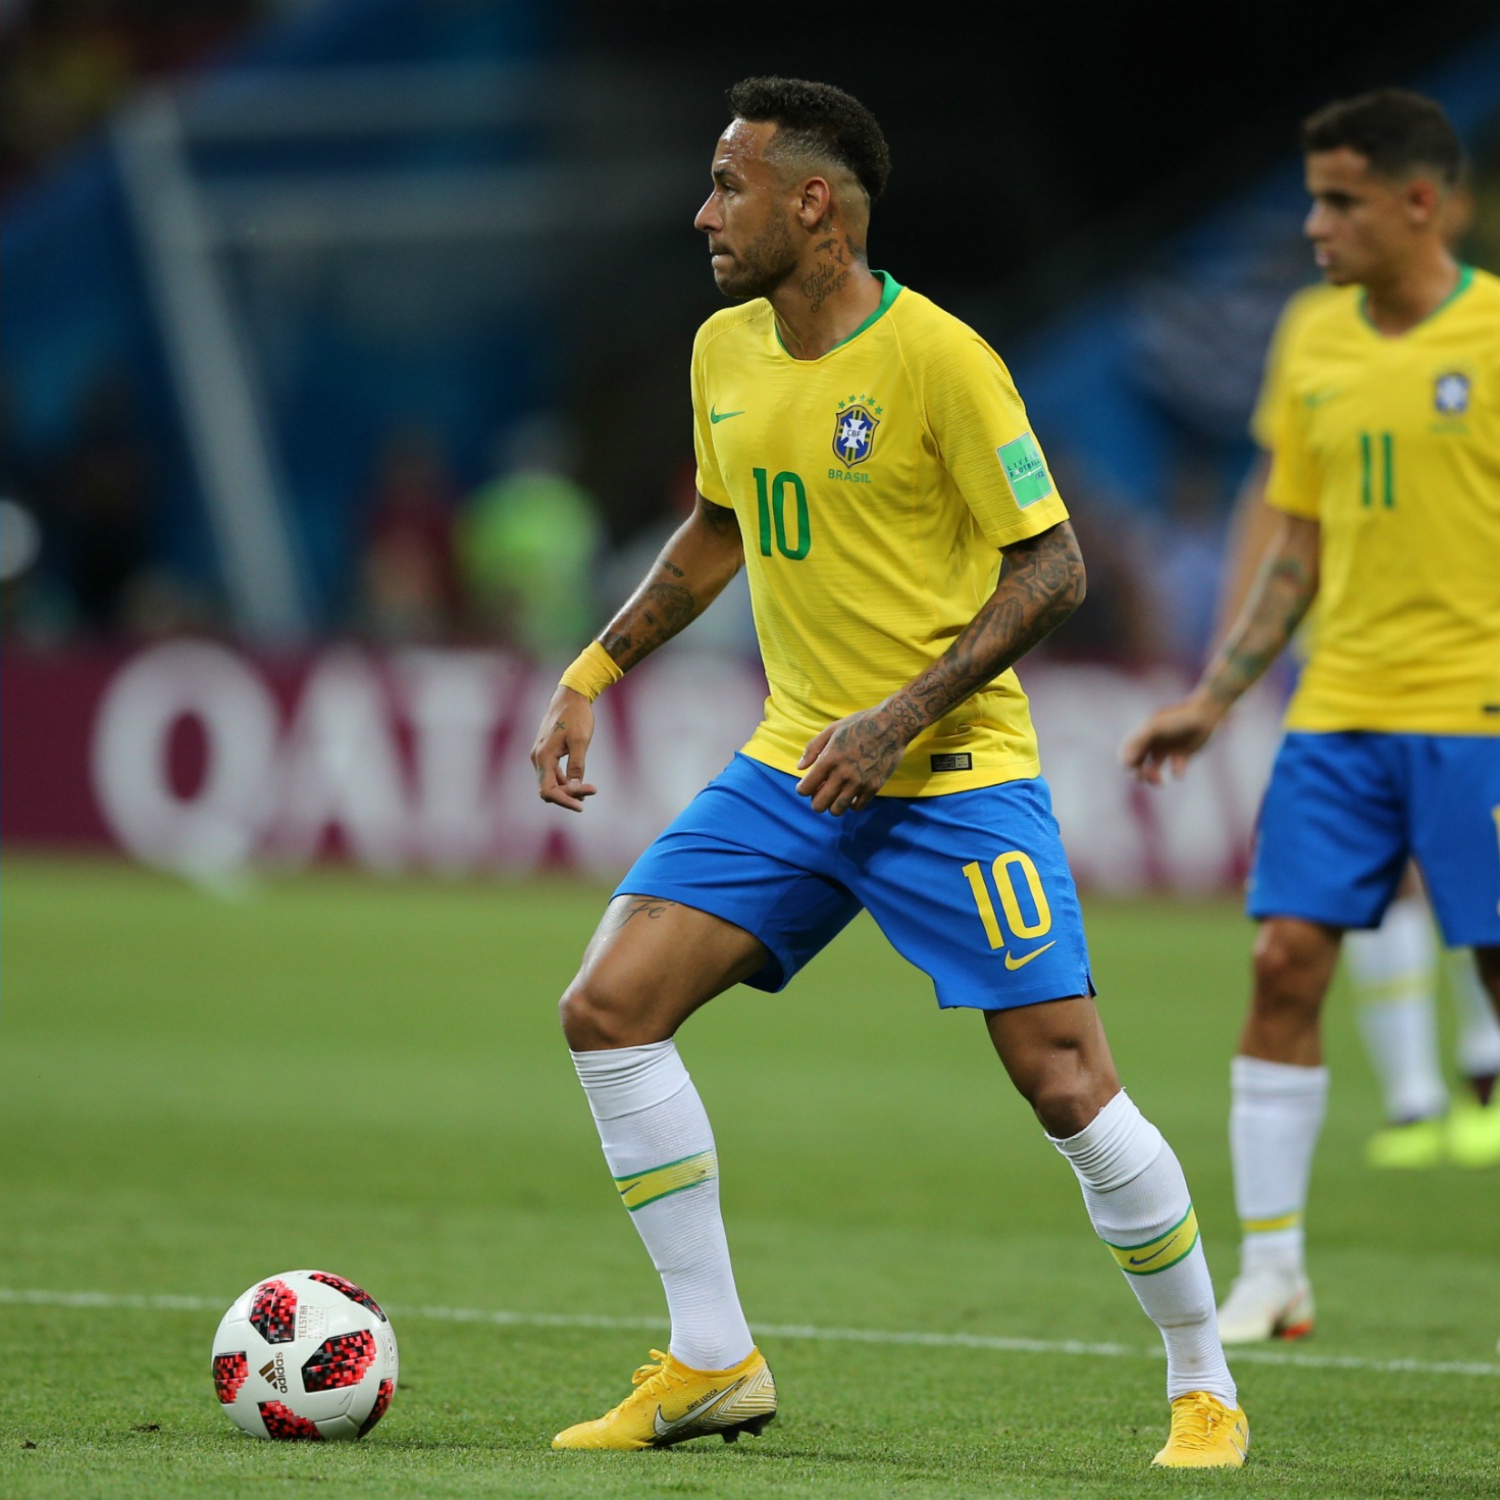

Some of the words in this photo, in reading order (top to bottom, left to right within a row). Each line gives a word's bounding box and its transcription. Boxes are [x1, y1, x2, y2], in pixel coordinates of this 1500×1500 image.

[846, 428, 861, 438] CBF
[828, 468, 872, 483] BRASIL
[1360, 432, 1395, 509] 11
[753, 467, 812, 562] 10
[962, 850, 1052, 950] 10
[275, 1352, 288, 1393] adidas
